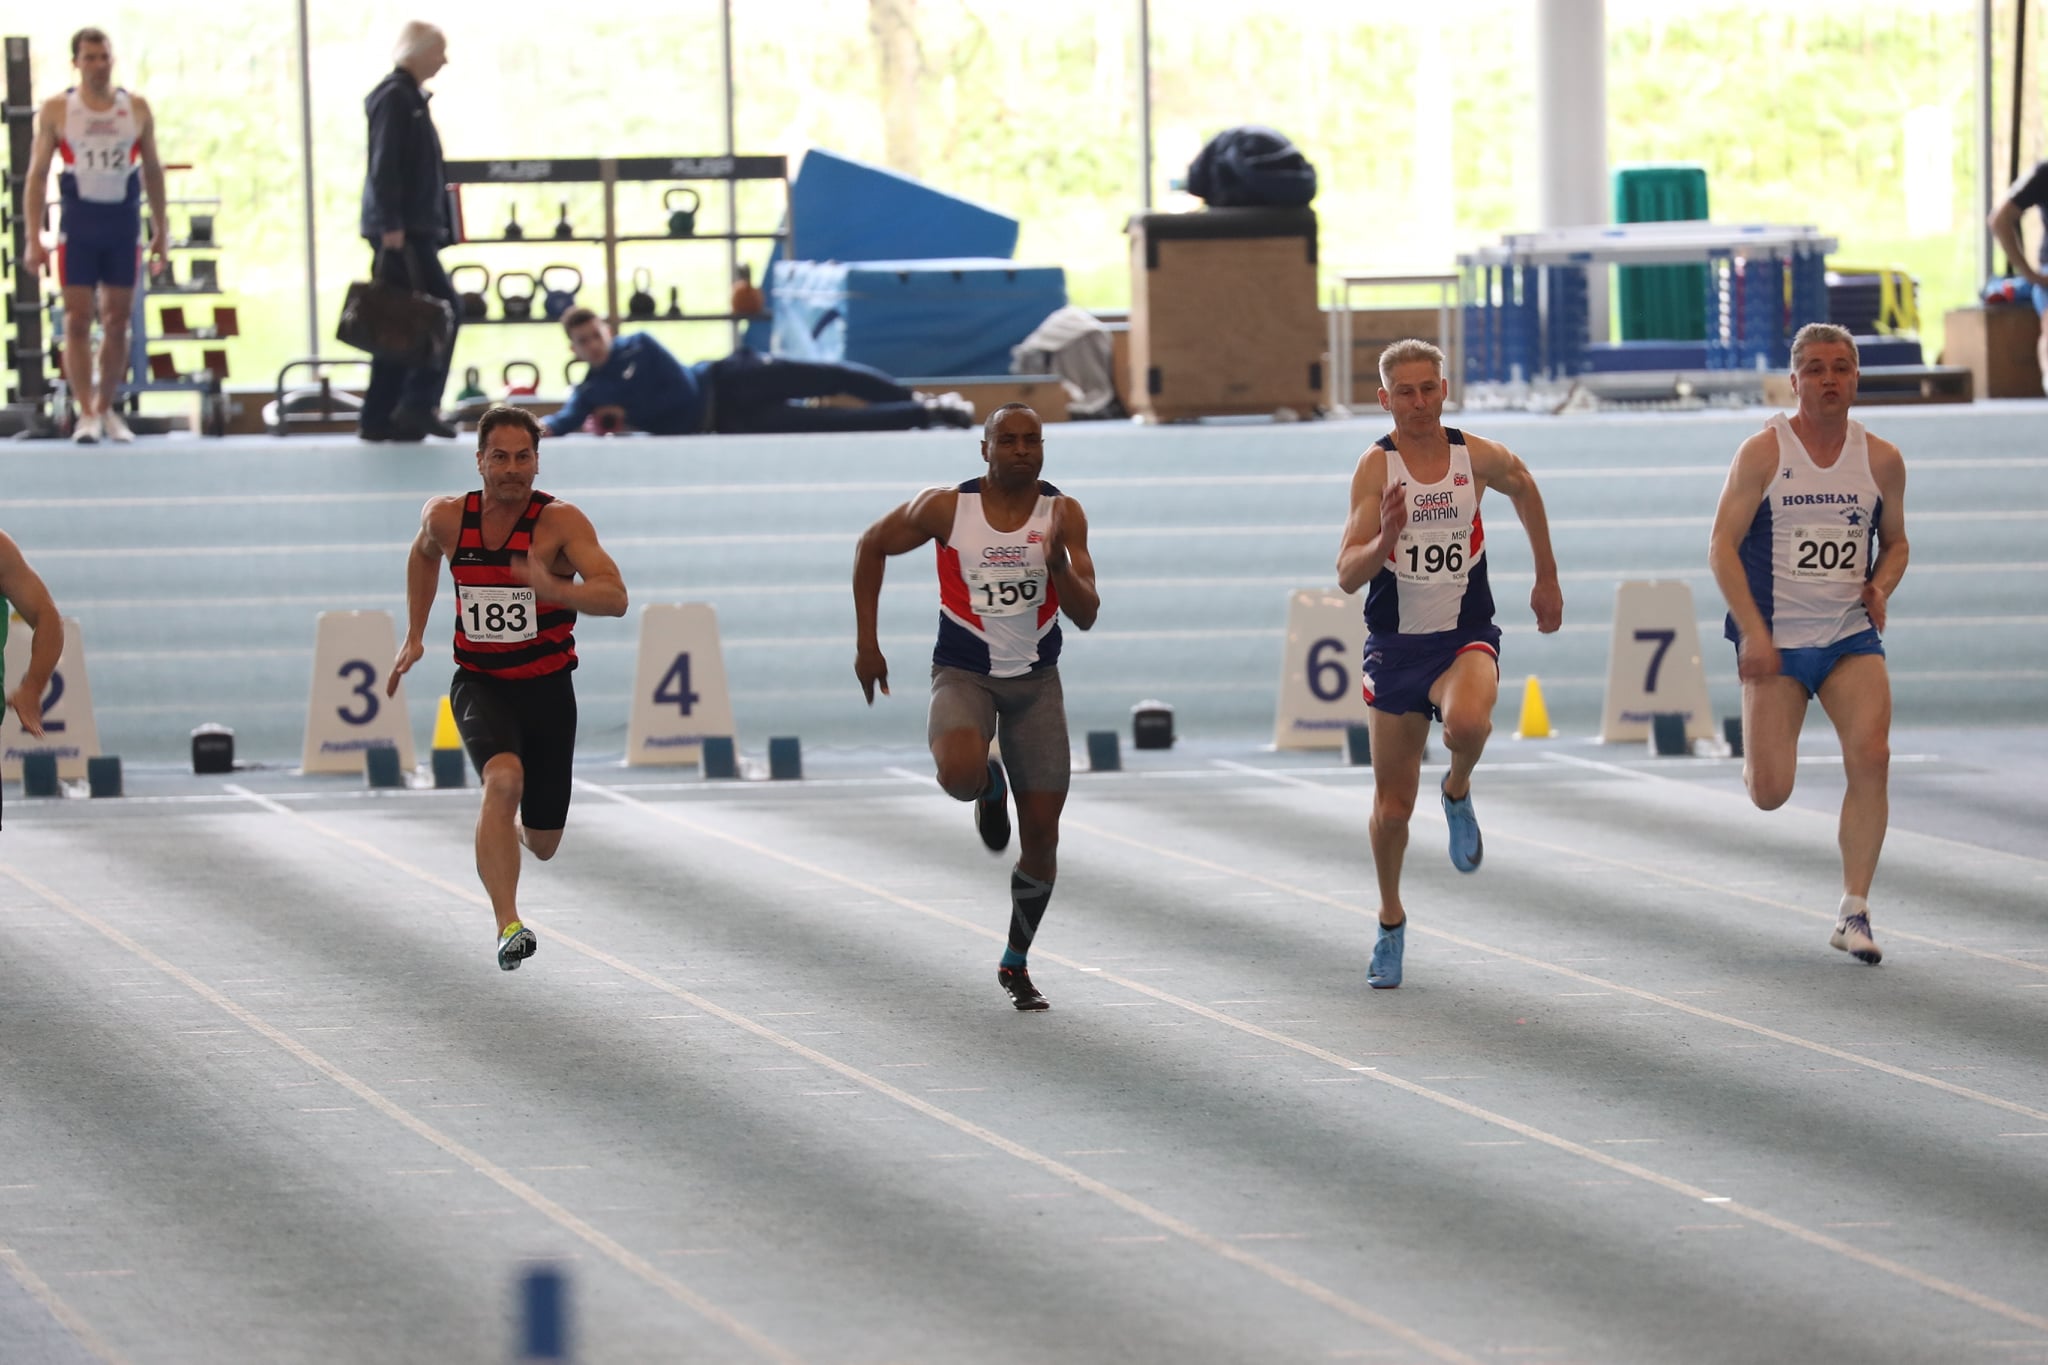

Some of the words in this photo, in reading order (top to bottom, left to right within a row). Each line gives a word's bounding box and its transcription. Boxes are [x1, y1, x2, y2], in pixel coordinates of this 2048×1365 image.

[85, 149, 124, 169] 112
[1413, 491, 1453, 507] GREAT
[1782, 494, 1859, 506] HORSHAM
[1412, 506, 1458, 523] BRITAIN
[1451, 530, 1467, 541] M50
[1847, 529, 1863, 538] M50
[1405, 543, 1463, 574] 196
[1797, 540, 1857, 570] 202
[512, 591, 532, 601] M50
[979, 579, 1037, 606] 156
[468, 602, 528, 632] 183
[1306, 636, 1350, 703] 6
[1633, 629, 1677, 694] 7
[336, 659, 380, 726] 3
[652, 651, 700, 718] 4
[20, 670, 65, 732] 2
